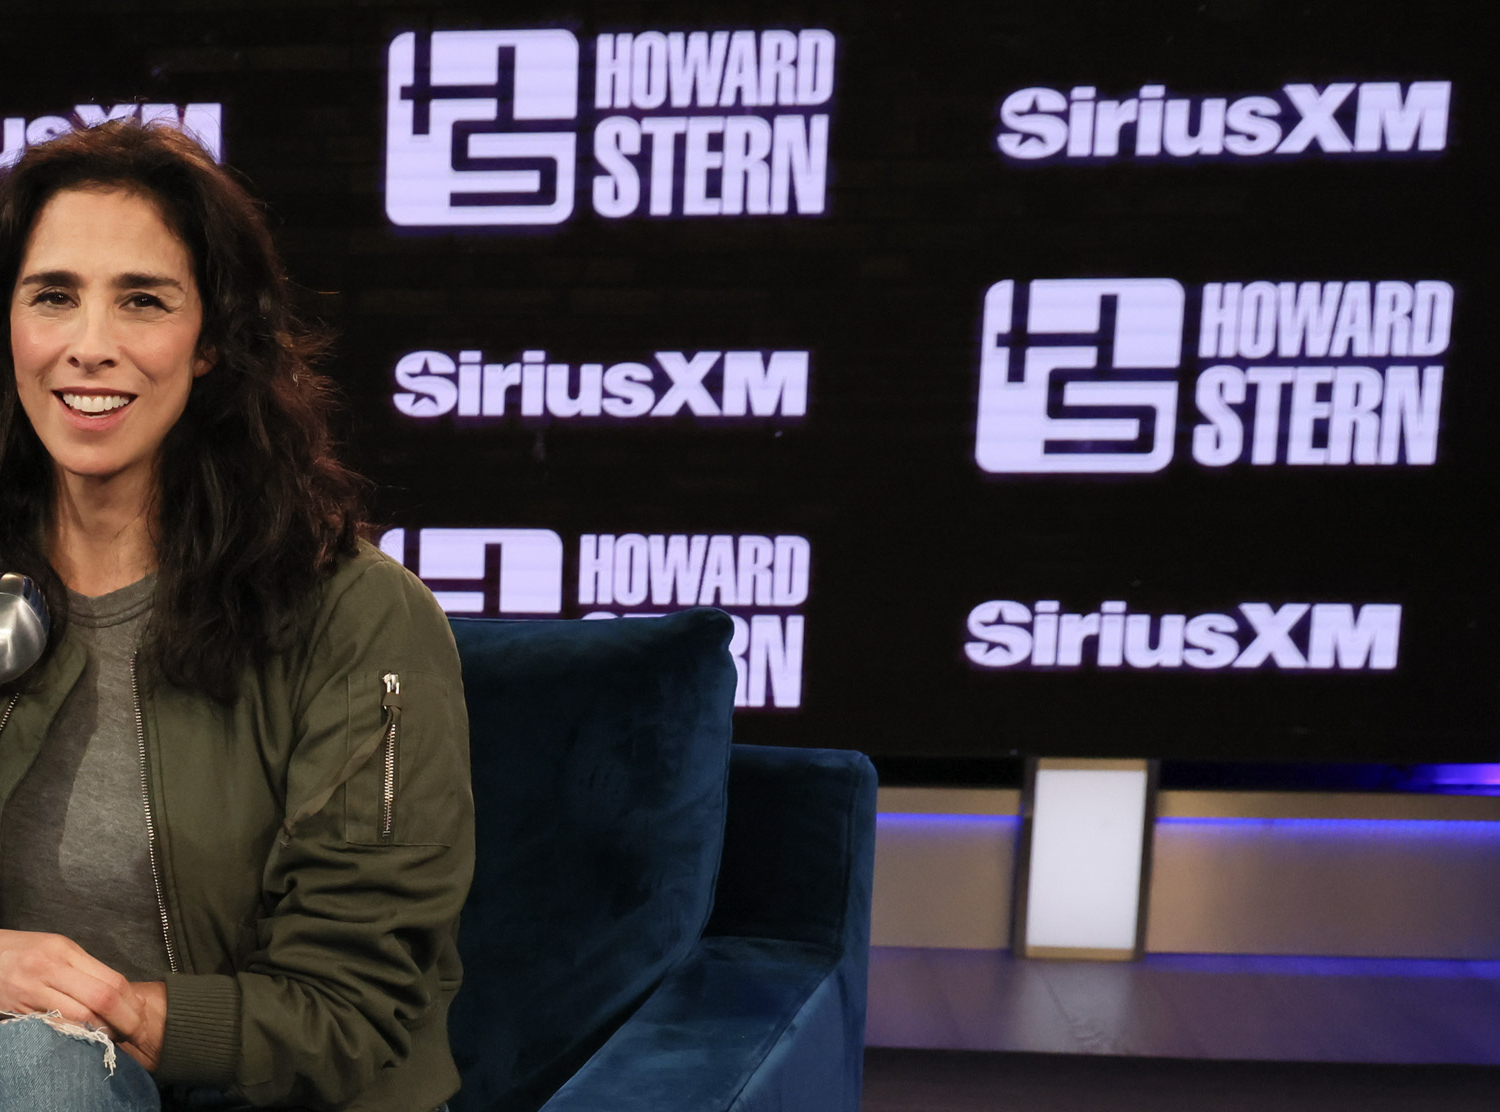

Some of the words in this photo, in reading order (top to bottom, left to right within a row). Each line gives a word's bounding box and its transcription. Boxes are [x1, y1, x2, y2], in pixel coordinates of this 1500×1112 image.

[595, 29, 836, 109] HOWARD
[998, 81, 1452, 159] SiriusXM
[592, 115, 829, 218] STERN
[1198, 280, 1454, 358] HOWARD
[393, 350, 809, 417] SiriusXM
[1192, 365, 1444, 467] STERN
[578, 533, 811, 607] HOWARD
[964, 600, 1402, 670] SiriusXM
